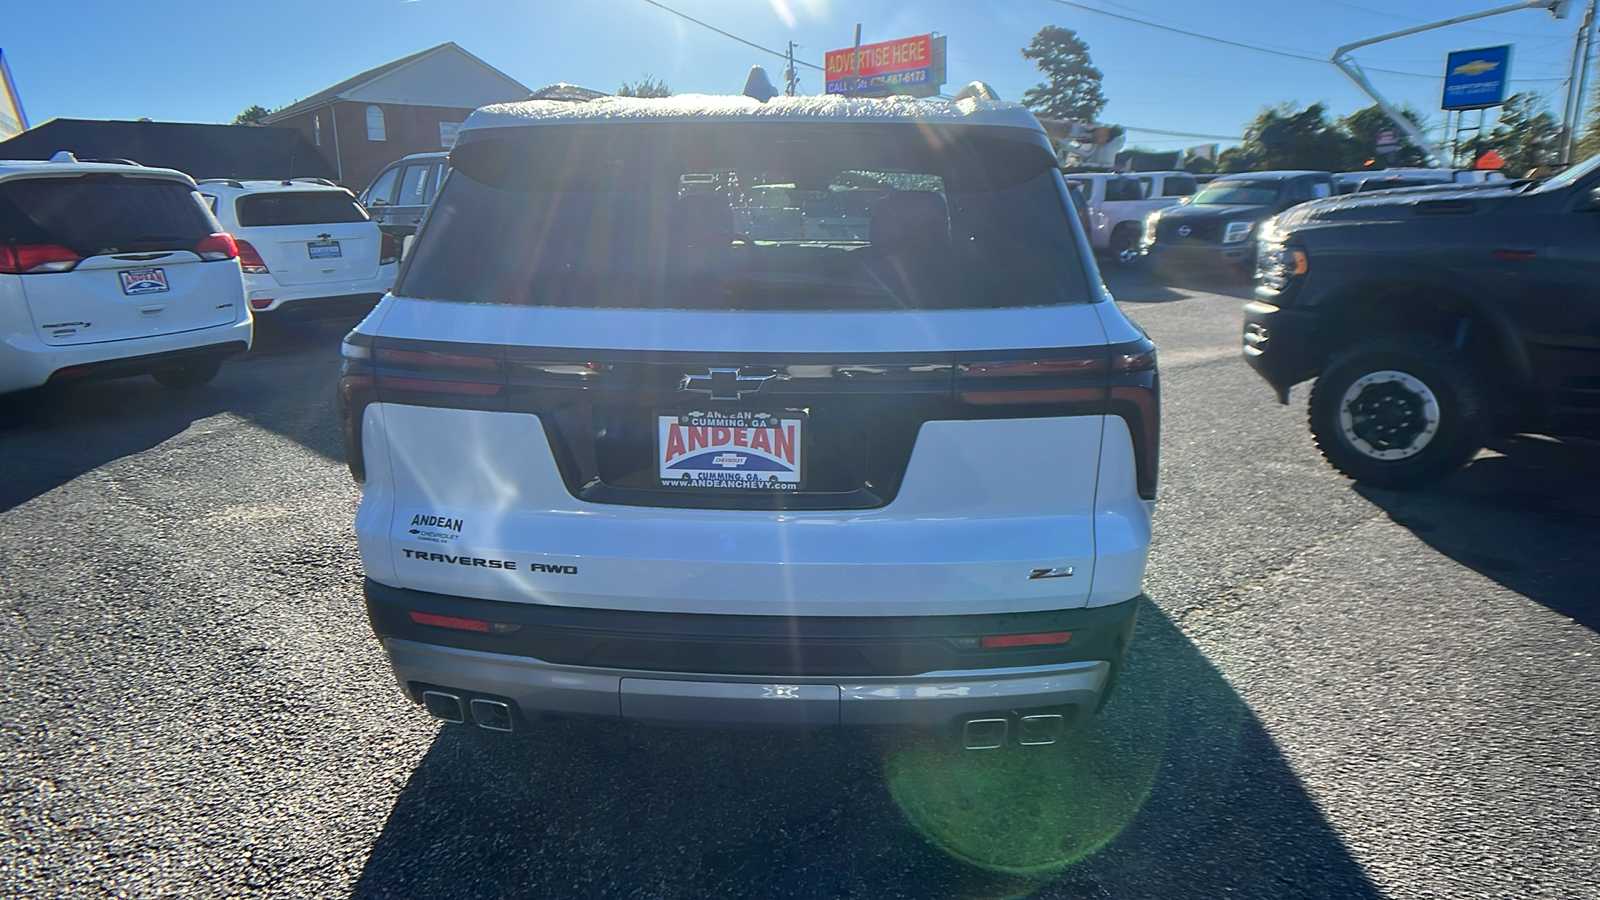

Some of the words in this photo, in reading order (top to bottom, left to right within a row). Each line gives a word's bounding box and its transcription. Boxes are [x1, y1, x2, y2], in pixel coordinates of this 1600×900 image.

[828, 46, 890, 73] ADVERTISE
[892, 40, 926, 64] HERE
[828, 81, 847, 93] CALL
[125, 271, 165, 287] ANDEAN
[691, 418, 748, 428] CUMMING,
[751, 420, 767, 428] GA
[665, 423, 795, 466] ANDEAN
[661, 479, 797, 490] www.ANDEANCHEVY.com
[411, 513, 464, 533] ANDEAN
[420, 530, 460, 541] CHEVROLET
[402, 549, 517, 570] TRAVERSE
[530, 563, 578, 575] AWD
